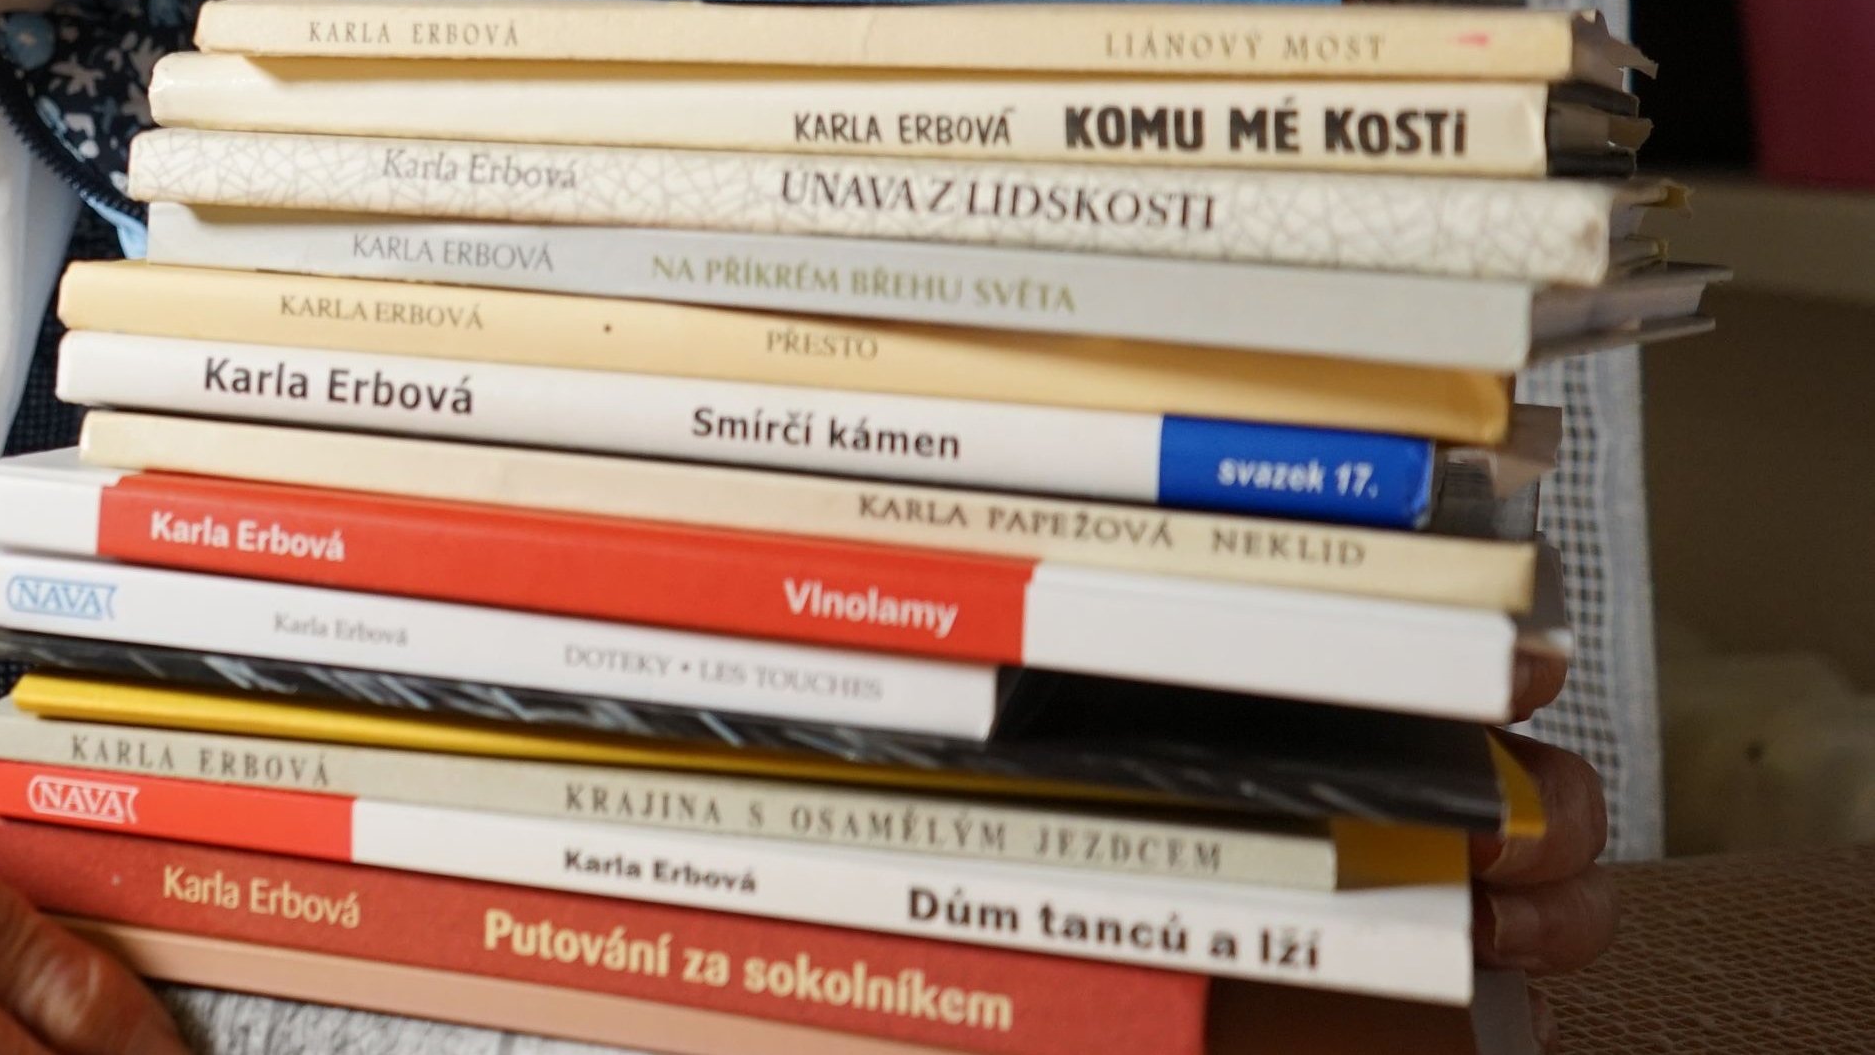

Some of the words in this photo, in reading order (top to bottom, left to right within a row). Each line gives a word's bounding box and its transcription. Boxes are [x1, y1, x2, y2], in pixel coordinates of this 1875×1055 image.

[309, 21, 392, 45] KARLA
[411, 19, 518, 46] ERBOVÁ
[1105, 27, 1261, 59] LIÁNOVÝ
[1284, 33, 1386, 60] MOST
[795, 113, 881, 143] KARLA
[898, 106, 1015, 145] ERBOVÁ
[1065, 106, 1203, 151] KOMU
[1230, 96, 1299, 152] MÉ
[382, 150, 458, 187] Karla
[468, 155, 577, 191] Erbová
[928, 179, 956, 212] Z
[966, 179, 1217, 230] LIDSKOSTI
[353, 233, 432, 263] KARLA
[443, 238, 555, 272] ERBOVÁ
[652, 256, 694, 283] NA
[705, 257, 840, 293] PŘÍKRÉM
[851, 268, 963, 303] BŘEHU
[974, 279, 1076, 313] SVĚTA
[281, 295, 367, 322] KARLA
[374, 300, 484, 330] ERBOVÁ
[766, 328, 879, 360] PŘESTO
[204, 356, 309, 400] Karla
[328, 368, 473, 415] Erbová
[692, 406, 813, 447] Smírčí
[829, 417, 961, 459] kámen
[1219, 456, 1323, 491] svazek
[150, 511, 229, 548] Karla
[236, 522, 346, 563] Erbová
[858, 494, 968, 528] KARLA
[988, 505, 1174, 548] PAPEŽOVÁ
[1212, 527, 1365, 566] NEKLID
[17, 577, 103, 615] NAVA
[782, 579, 958, 638] Vlnolamy
[273, 612, 328, 639] Karla
[334, 618, 408, 648] Erbová
[564, 645, 672, 676] DOTEKY
[700, 659, 746, 685] LES
[755, 665, 884, 699] TOUCHES
[71, 735, 176, 771] KARLA
[199, 748, 331, 786] ERBOVÁ
[37, 782, 127, 821] NAVA
[566, 785, 721, 825] KRAJINA
[749, 801, 764, 826] S
[791, 802, 1008, 851] OSAMĚLÝM
[1034, 827, 1223, 872] JEZDCEM
[565, 850, 641, 878] Karla
[653, 861, 756, 892] Erbová
[164, 866, 239, 909] Karla
[250, 877, 361, 929] Erbová
[484, 909, 671, 979] Putování
[682, 947, 729, 985] za
[744, 954, 1013, 1032] sokolníkem
[1210, 931, 1237, 956] a
[1260, 926, 1320, 971] lží
